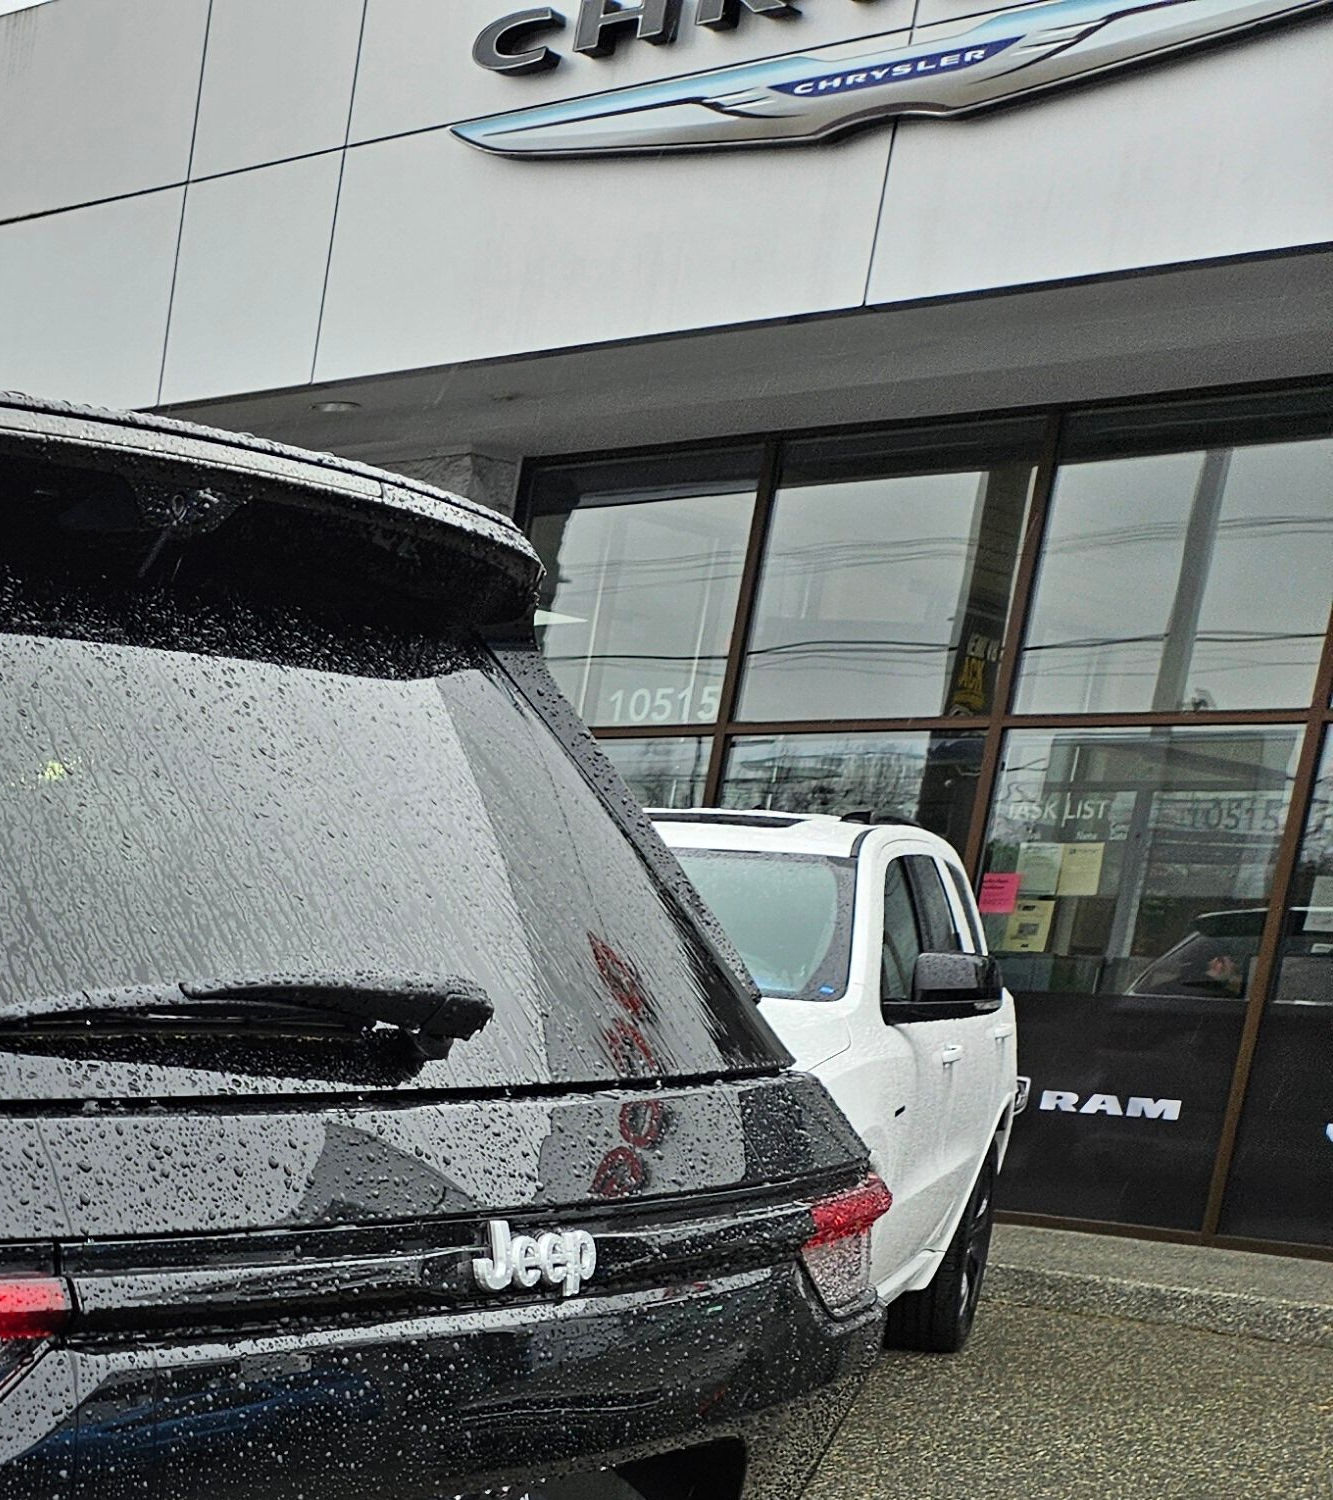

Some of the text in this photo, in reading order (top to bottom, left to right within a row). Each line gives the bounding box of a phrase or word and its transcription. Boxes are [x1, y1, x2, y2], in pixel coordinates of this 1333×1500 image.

[793, 48, 988, 95] CHRYSLER
[609, 685, 720, 724] 10515
[1039, 1089, 1182, 1121] RAM
[472, 1220, 597, 1297] Jeep
